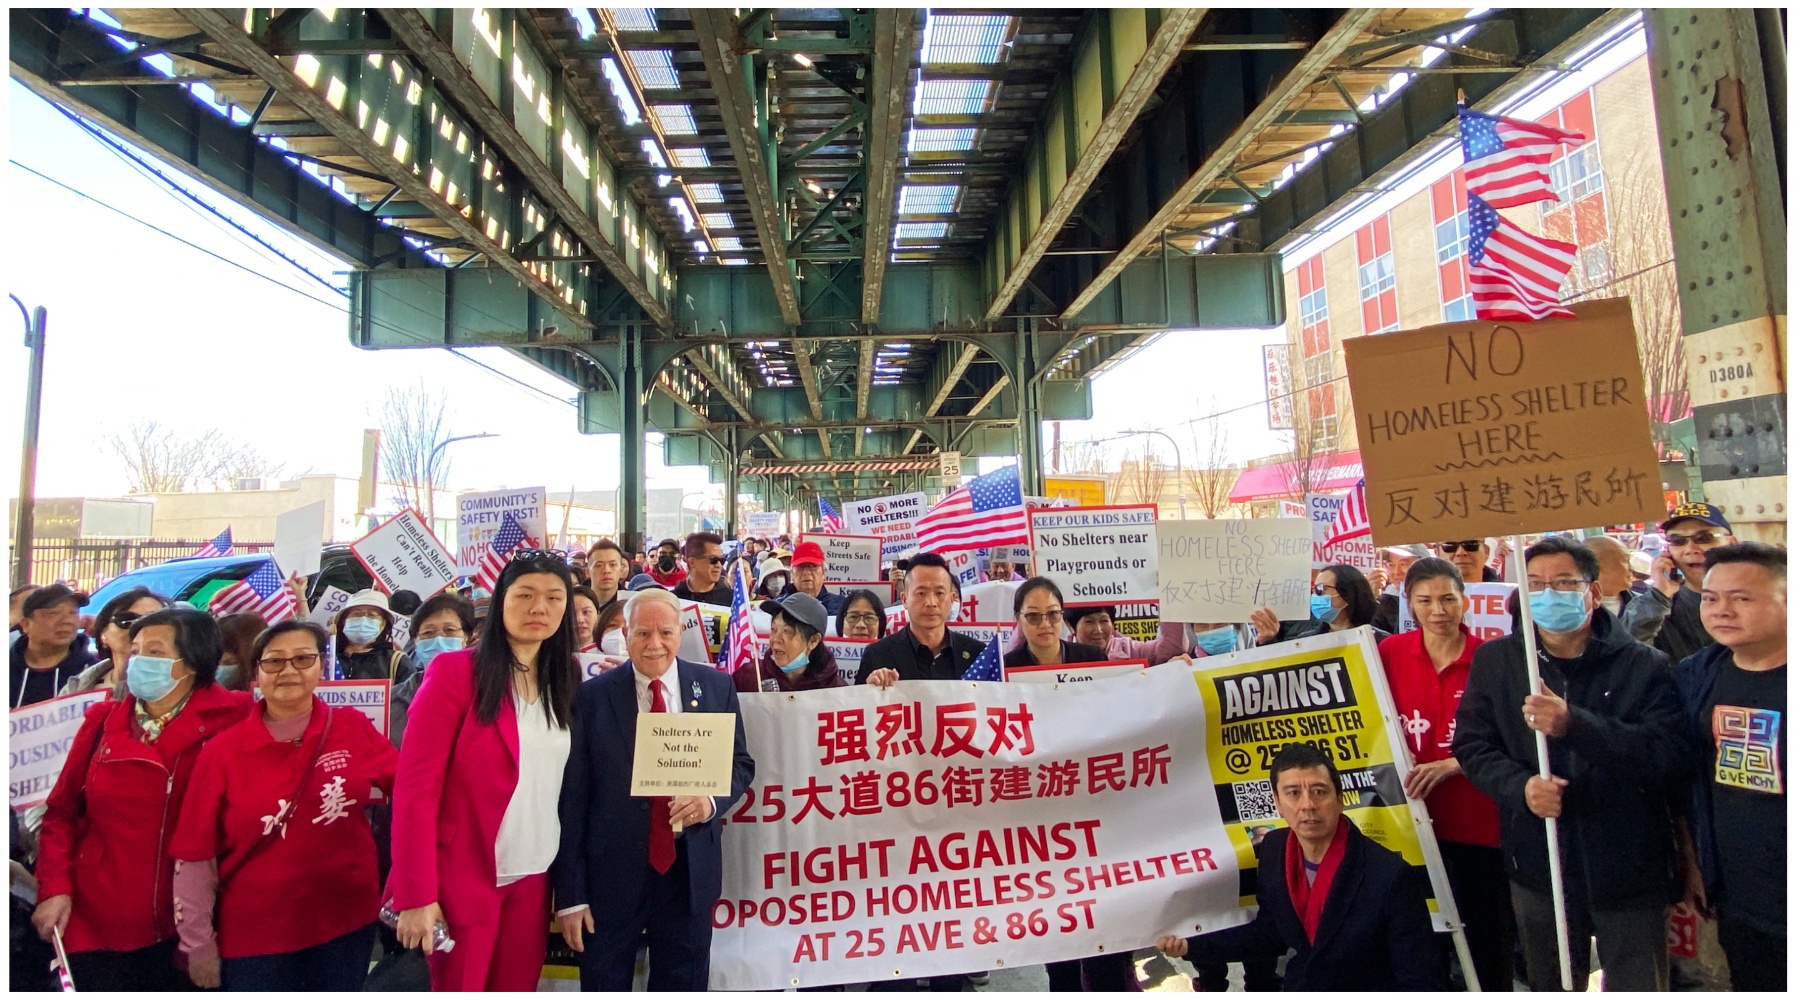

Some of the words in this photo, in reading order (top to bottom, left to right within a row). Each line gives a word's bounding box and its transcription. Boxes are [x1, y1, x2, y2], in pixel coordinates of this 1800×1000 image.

[1445, 325, 1524, 384] NO
[1709, 363, 1753, 383] D380A
[1367, 394, 1504, 444] HOMELESS
[1511, 377, 1632, 418] SHELTER
[1458, 421, 1543, 459] HERE
[943, 466, 959, 475] 25
[460, 493, 538, 511] COMMUNITY'S
[857, 505, 872, 514] NO
[889, 498, 919, 509] MORE
[1384, 466, 1647, 528] 反对建游民所
[460, 511, 500, 525] SAFETY
[860, 509, 919, 525] SHELTERS!!!
[1033, 516, 1062, 527] KEEP
[1065, 515, 1090, 525] OUR
[1093, 513, 1120, 524] KIDS
[1122, 512, 1155, 523] SAFE!
[871, 526, 886, 534] WE
[887, 522, 911, 532] NEED
[1225, 519, 1247, 536] NO
[400, 514, 430, 550] Homeless
[428, 549, 454, 580] Shelters
[829, 538, 850, 549] Keep
[1040, 533, 1058, 547] No
[1062, 532, 1115, 547] Shelters
[1119, 533, 1149, 544] near
[1160, 535, 1265, 559] HOMELESS
[1268, 535, 1312, 557] SHELTER
[366, 554, 378, 567] the
[396, 533, 416, 556] Can't
[412, 554, 434, 579] Really
[461, 545, 477, 567] NO
[826, 551, 852, 559] Streets
[854, 552, 871, 560] Safe
[1313, 541, 1334, 563] NO
[391, 556, 408, 576] Help
[828, 563, 850, 573] Keep
[1046, 557, 1128, 574] Playgrounds
[1132, 558, 1147, 568] or
[1218, 557, 1266, 576] HERE
[1073, 581, 1128, 596] Schools!
[317, 690, 347, 704] KIDS
[349, 690, 385, 704] SAFE!
[1223, 662, 1346, 720] AGAINST
[652, 726, 692, 737] Shelters
[694, 727, 713, 737] Are
[818, 702, 1035, 766] 强烈反对
[1221, 718, 1297, 746] HOMELESS
[1297, 710, 1365, 737] SHELTER
[663, 742, 681, 752] Not
[683, 742, 699, 752] the
[1225, 748, 1252, 774] @
[1334, 734, 1369, 761] ST.
[657, 758, 702, 768] Solution!
[720, 743, 1172, 825] 25大道86街建游民所
[1353, 770, 1378, 788] THE
[1719, 769, 1775, 789] GIVENCHY
[764, 839, 896, 889] FIGHT
[908, 819, 1101, 875] AGAINST
[711, 890, 856, 929] OPOSED
[866, 870, 1056, 918] HOMELESS
[1063, 848, 1219, 895] SHELTER
[792, 931, 836, 963] AT
[845, 927, 886, 959] 25
[896, 919, 964, 954] AVE
[973, 916, 999, 945] &
[1006, 908, 1049, 940] 86
[1056, 898, 1097, 933] ST
